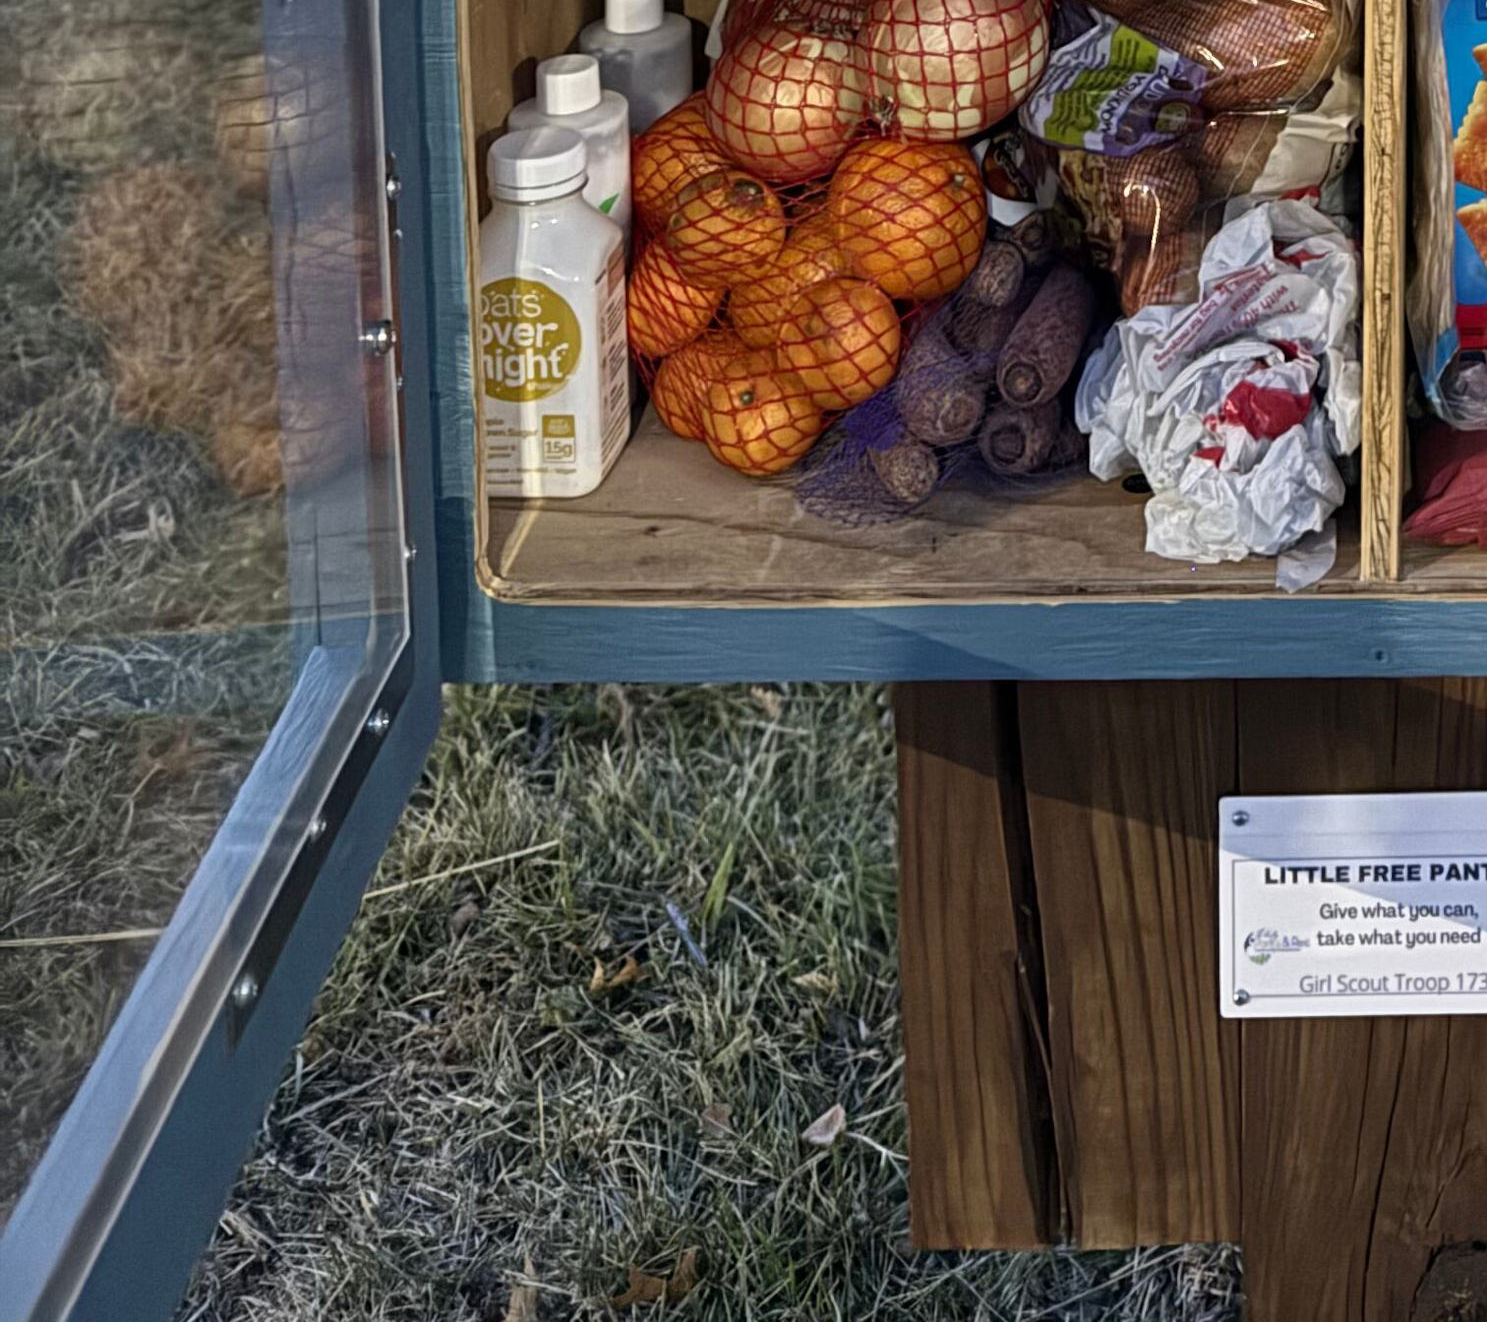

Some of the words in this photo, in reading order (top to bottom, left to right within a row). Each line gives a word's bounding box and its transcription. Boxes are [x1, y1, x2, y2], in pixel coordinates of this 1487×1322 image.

[545, 440, 574, 459] 15g
[1264, 865, 1351, 885] LITTLE
[1358, 864, 1422, 883] FREE
[1319, 903, 1358, 919] Give
[1361, 902, 1406, 919] what
[1408, 905, 1440, 923] you
[1443, 904, 1479, 919] can,
[1317, 929, 1356, 946] take
[1359, 928, 1402, 946] what
[1405, 931, 1437, 949] you
[1440, 927, 1481, 944] need
[1299, 975, 1332, 993] Girl
[1338, 975, 1391, 993] Scout
[1395, 973, 1450, 996] Troop
